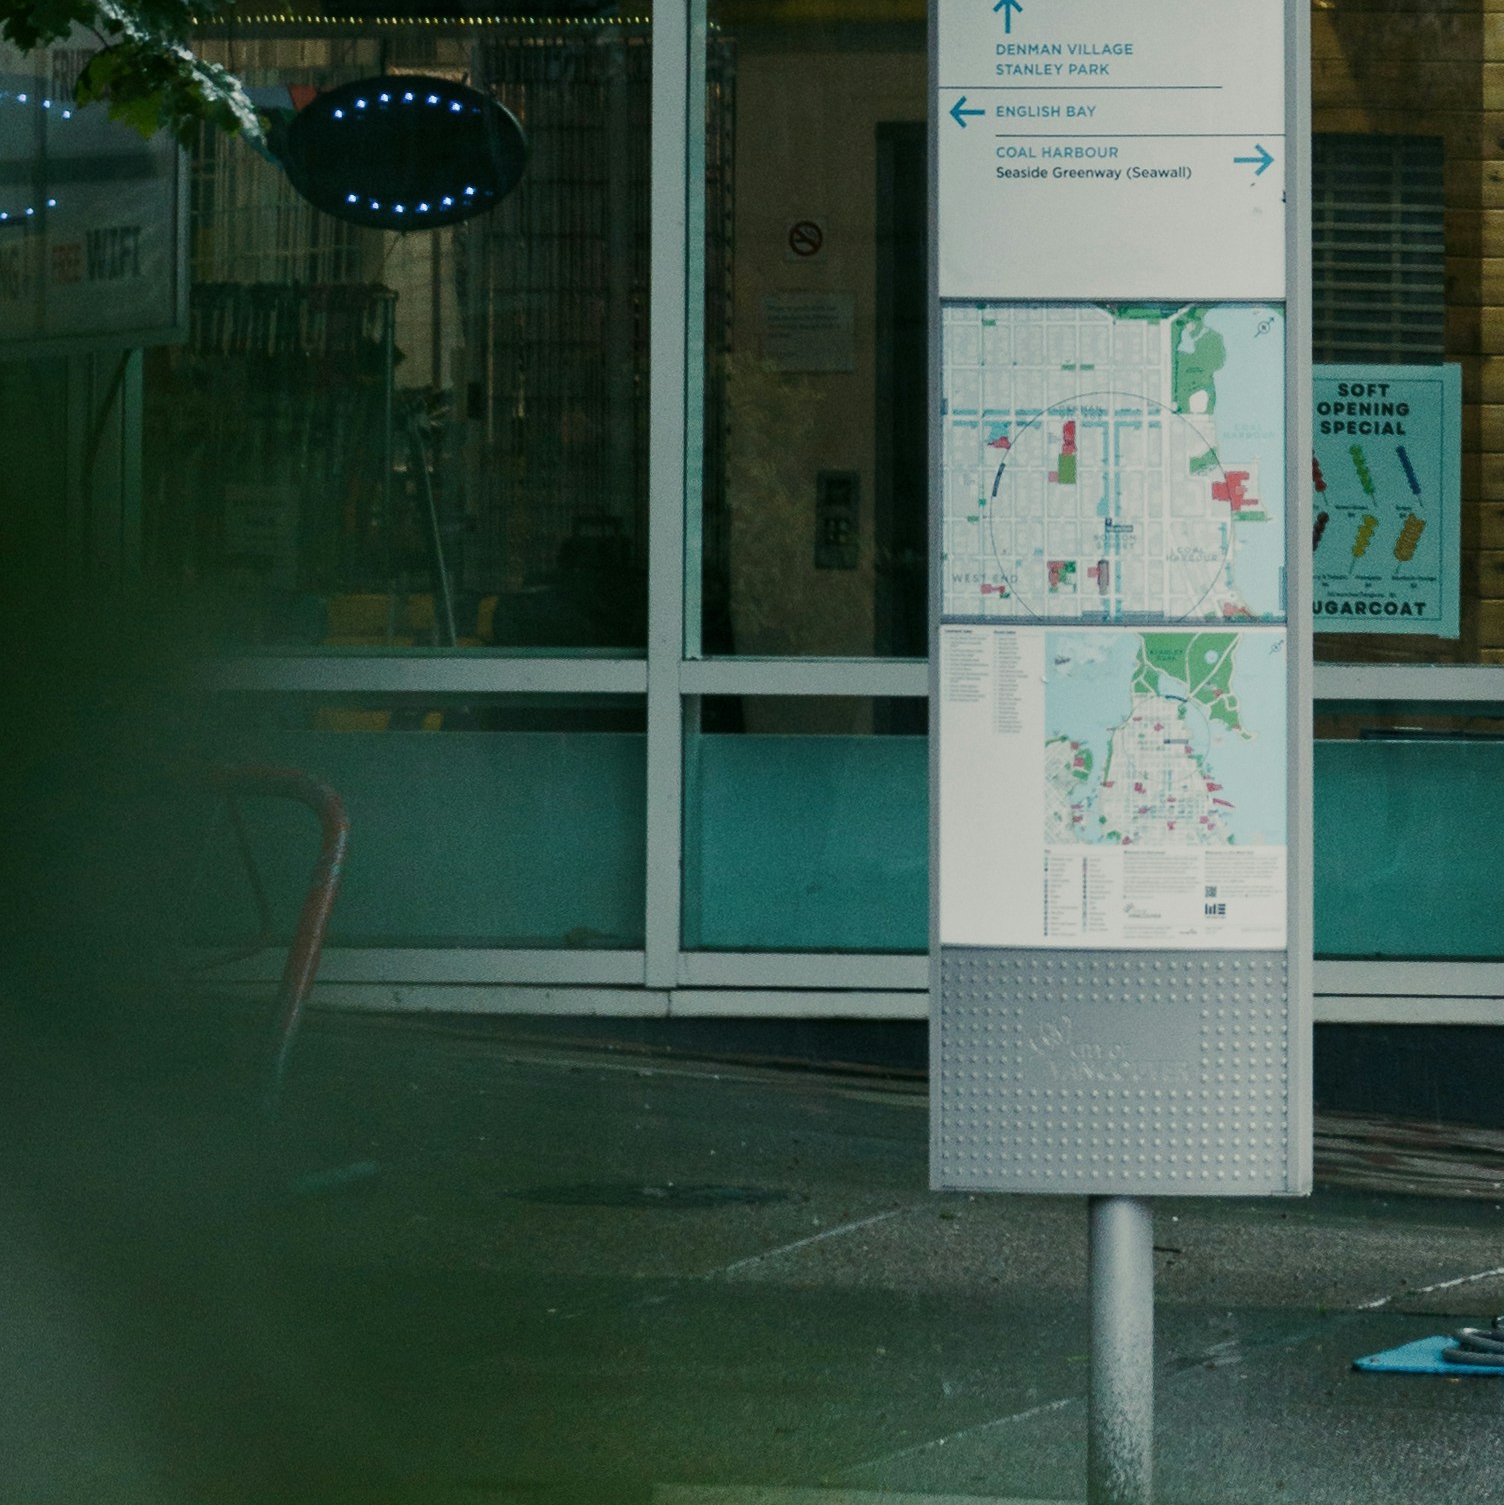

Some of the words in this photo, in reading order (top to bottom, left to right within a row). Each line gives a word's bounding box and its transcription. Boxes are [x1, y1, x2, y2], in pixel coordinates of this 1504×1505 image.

[995, 43, 1063, 55] DENMAN
[1068, 43, 1134, 55] VILLAGE
[995, 63, 1062, 76] STANLEY
[1067, 63, 1110, 76] PARK
[995, 105, 1061, 118] ENGLISH
[1066, 105, 1097, 118] BAY
[995, 146, 1036, 159] COAL
[1042, 146, 1119, 159] HARBOUR
[995, 166, 1049, 179] Seaside
[1053, 166, 1124, 182] Greenway
[1127, 165, 1193, 182] (Seawall)
[1338, 383, 1390, 398] SOFT
[1317, 402, 1410, 417] OPENING
[1320, 421, 1407, 436] SPECIAL
[1312, 600, 1427, 617] UGARCOAT
